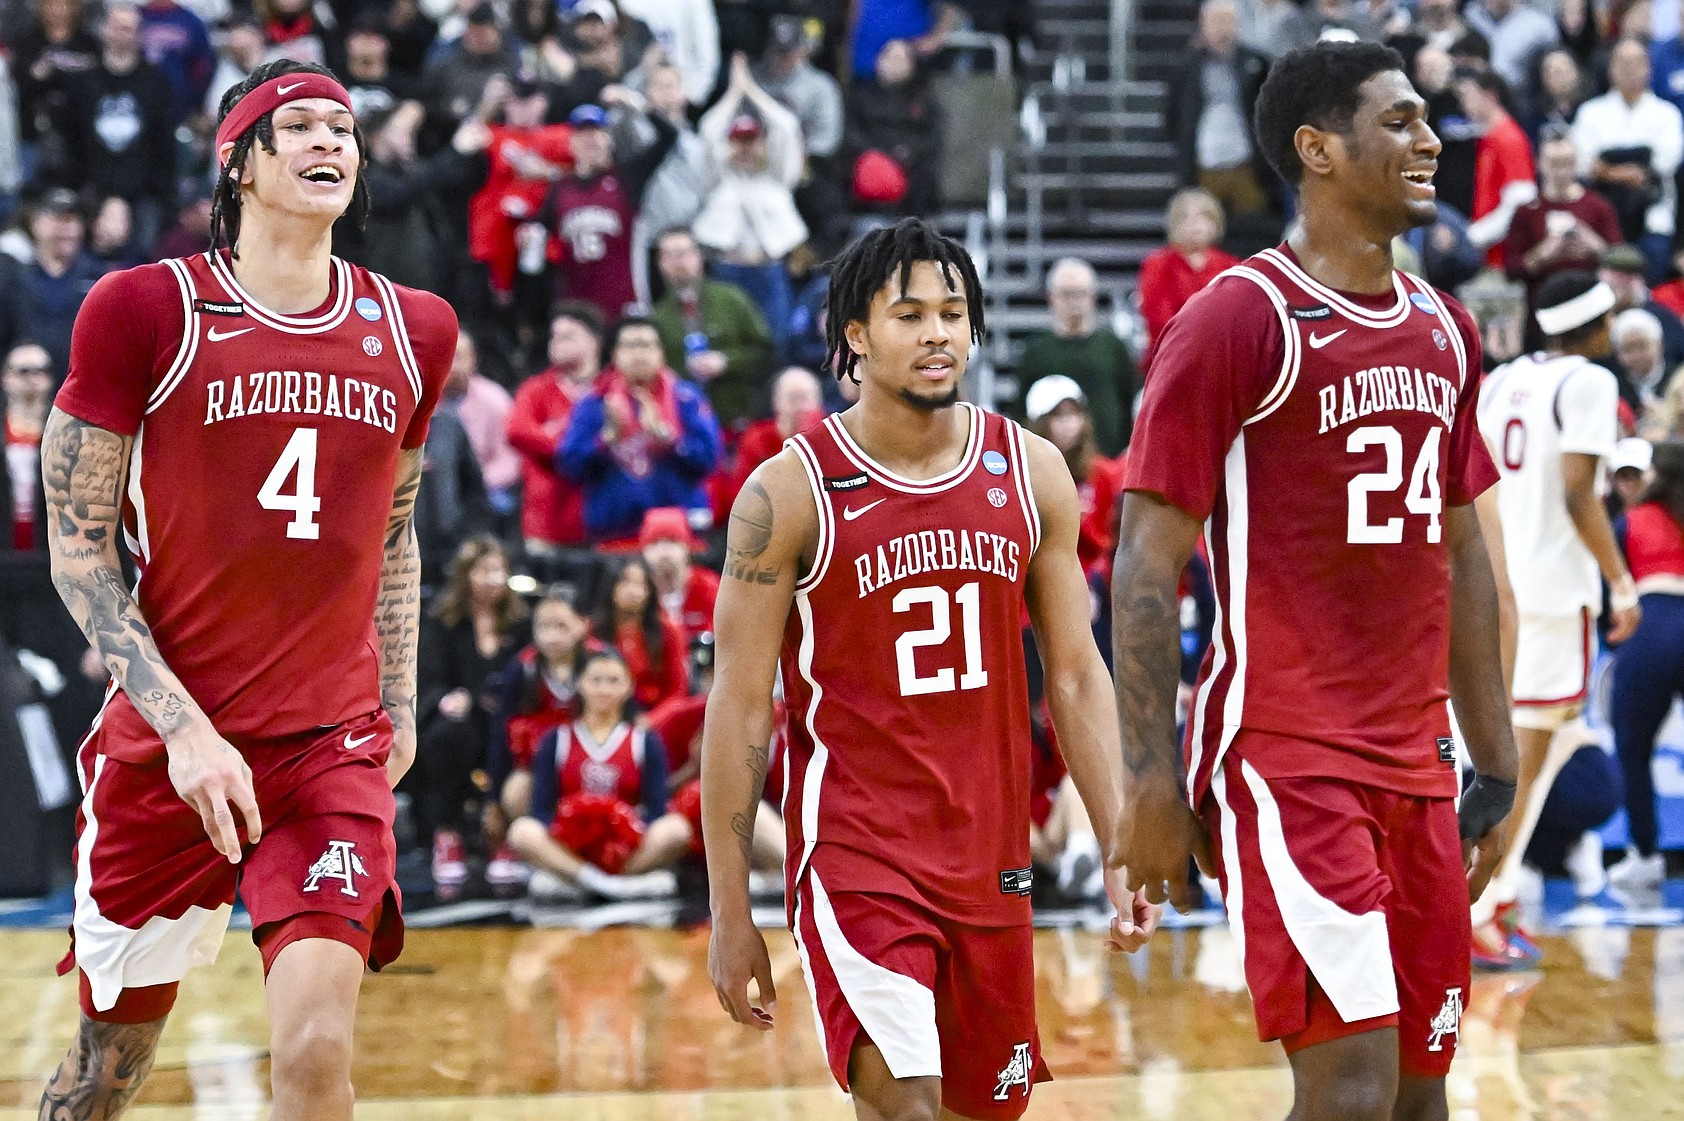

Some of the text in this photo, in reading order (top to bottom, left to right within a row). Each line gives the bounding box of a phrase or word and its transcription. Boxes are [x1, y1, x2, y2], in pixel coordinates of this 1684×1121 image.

[203, 303, 243, 313] TOGETHER
[364, 337, 381, 355] SEC
[203, 370, 397, 434] RAZORBACKS
[1318, 365, 1457, 434] RAZORBACKS
[1504, 417, 1527, 472] 0
[256, 427, 321, 540] 4
[831, 475, 868, 488] TOGETHER
[988, 489, 1006, 506] SEC
[1346, 425, 1443, 544] 24
[854, 529, 1020, 599] RAZORBACKS
[892, 581, 988, 697] 21
